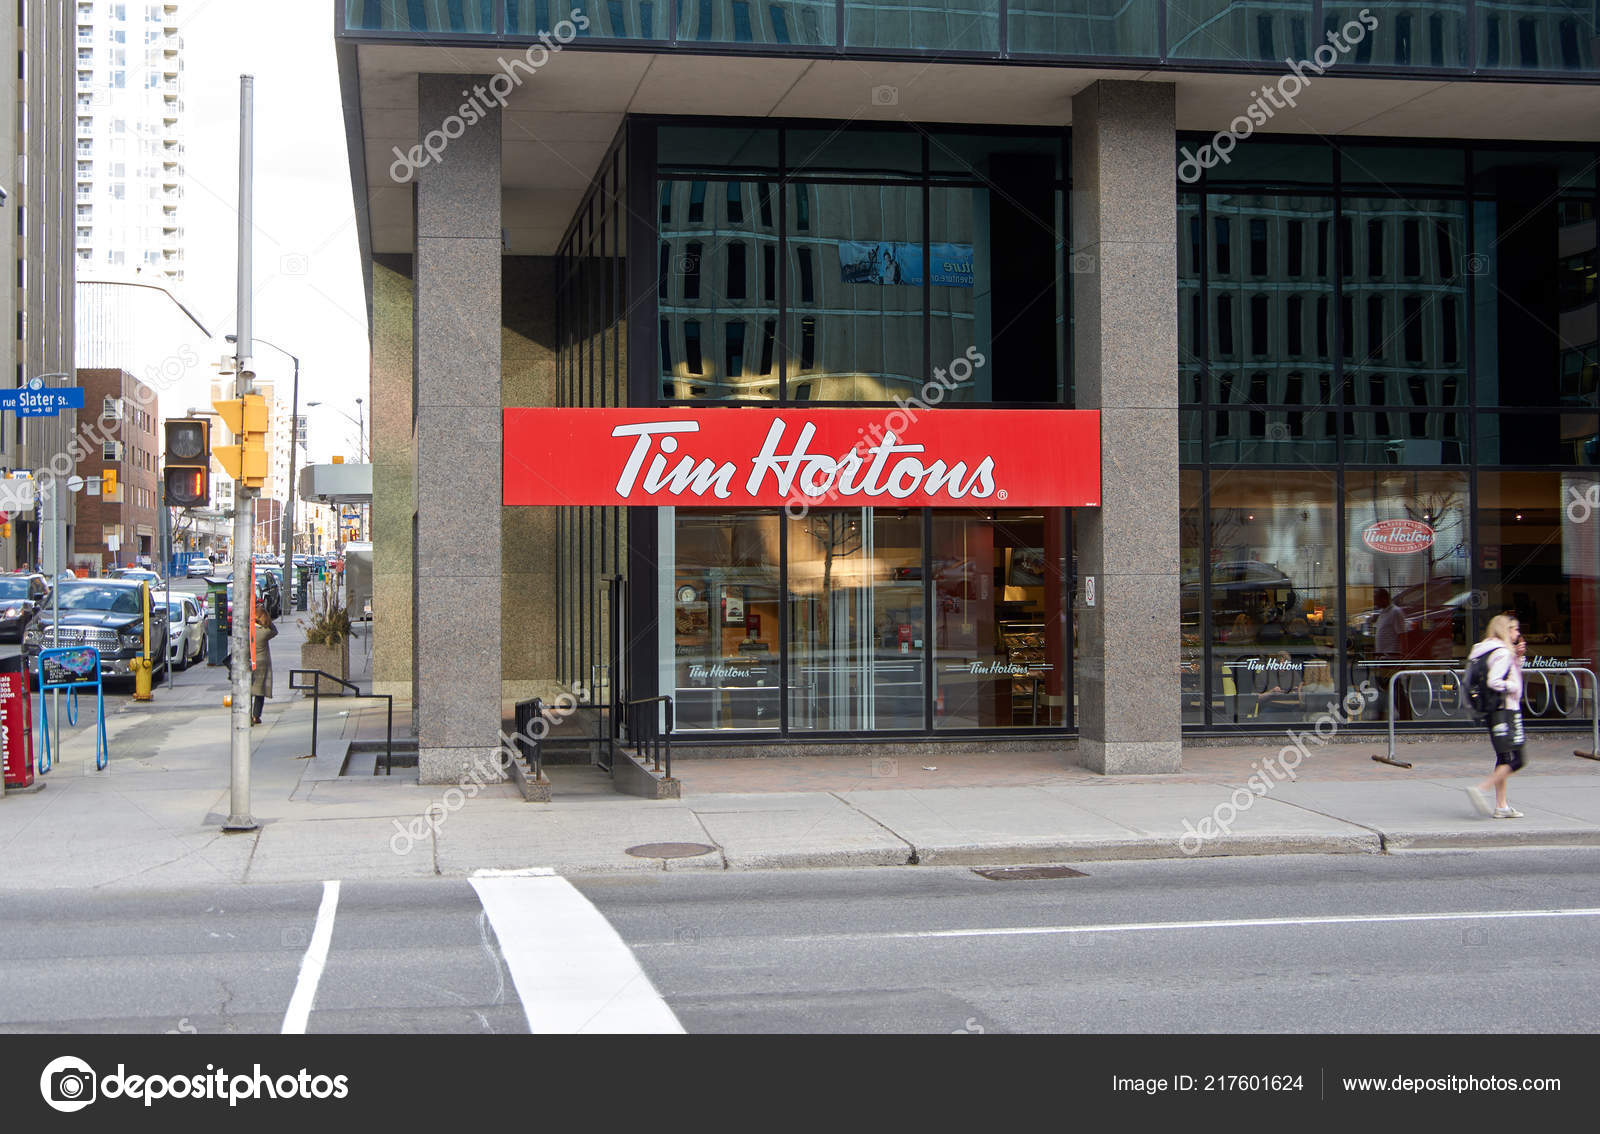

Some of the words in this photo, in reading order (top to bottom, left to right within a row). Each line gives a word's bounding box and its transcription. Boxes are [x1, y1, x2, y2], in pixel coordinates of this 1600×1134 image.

[3, 399, 16, 407] rue
[19, 392, 55, 407] Slater
[57, 396, 69, 405] St.
[611, 420, 737, 498] Tim
[745, 417, 995, 499] Hortons
[1361, 527, 1387, 543] Tim
[970, 661, 988, 674] Tim
[989, 660, 1028, 674] Hortons
[1246, 658, 1265, 671] Tim
[1266, 657, 1303, 671] Hortons
[1532, 655, 1568, 668] Hortons
[688, 664, 708, 677] Tim
[709, 664, 750, 678] Hortons
